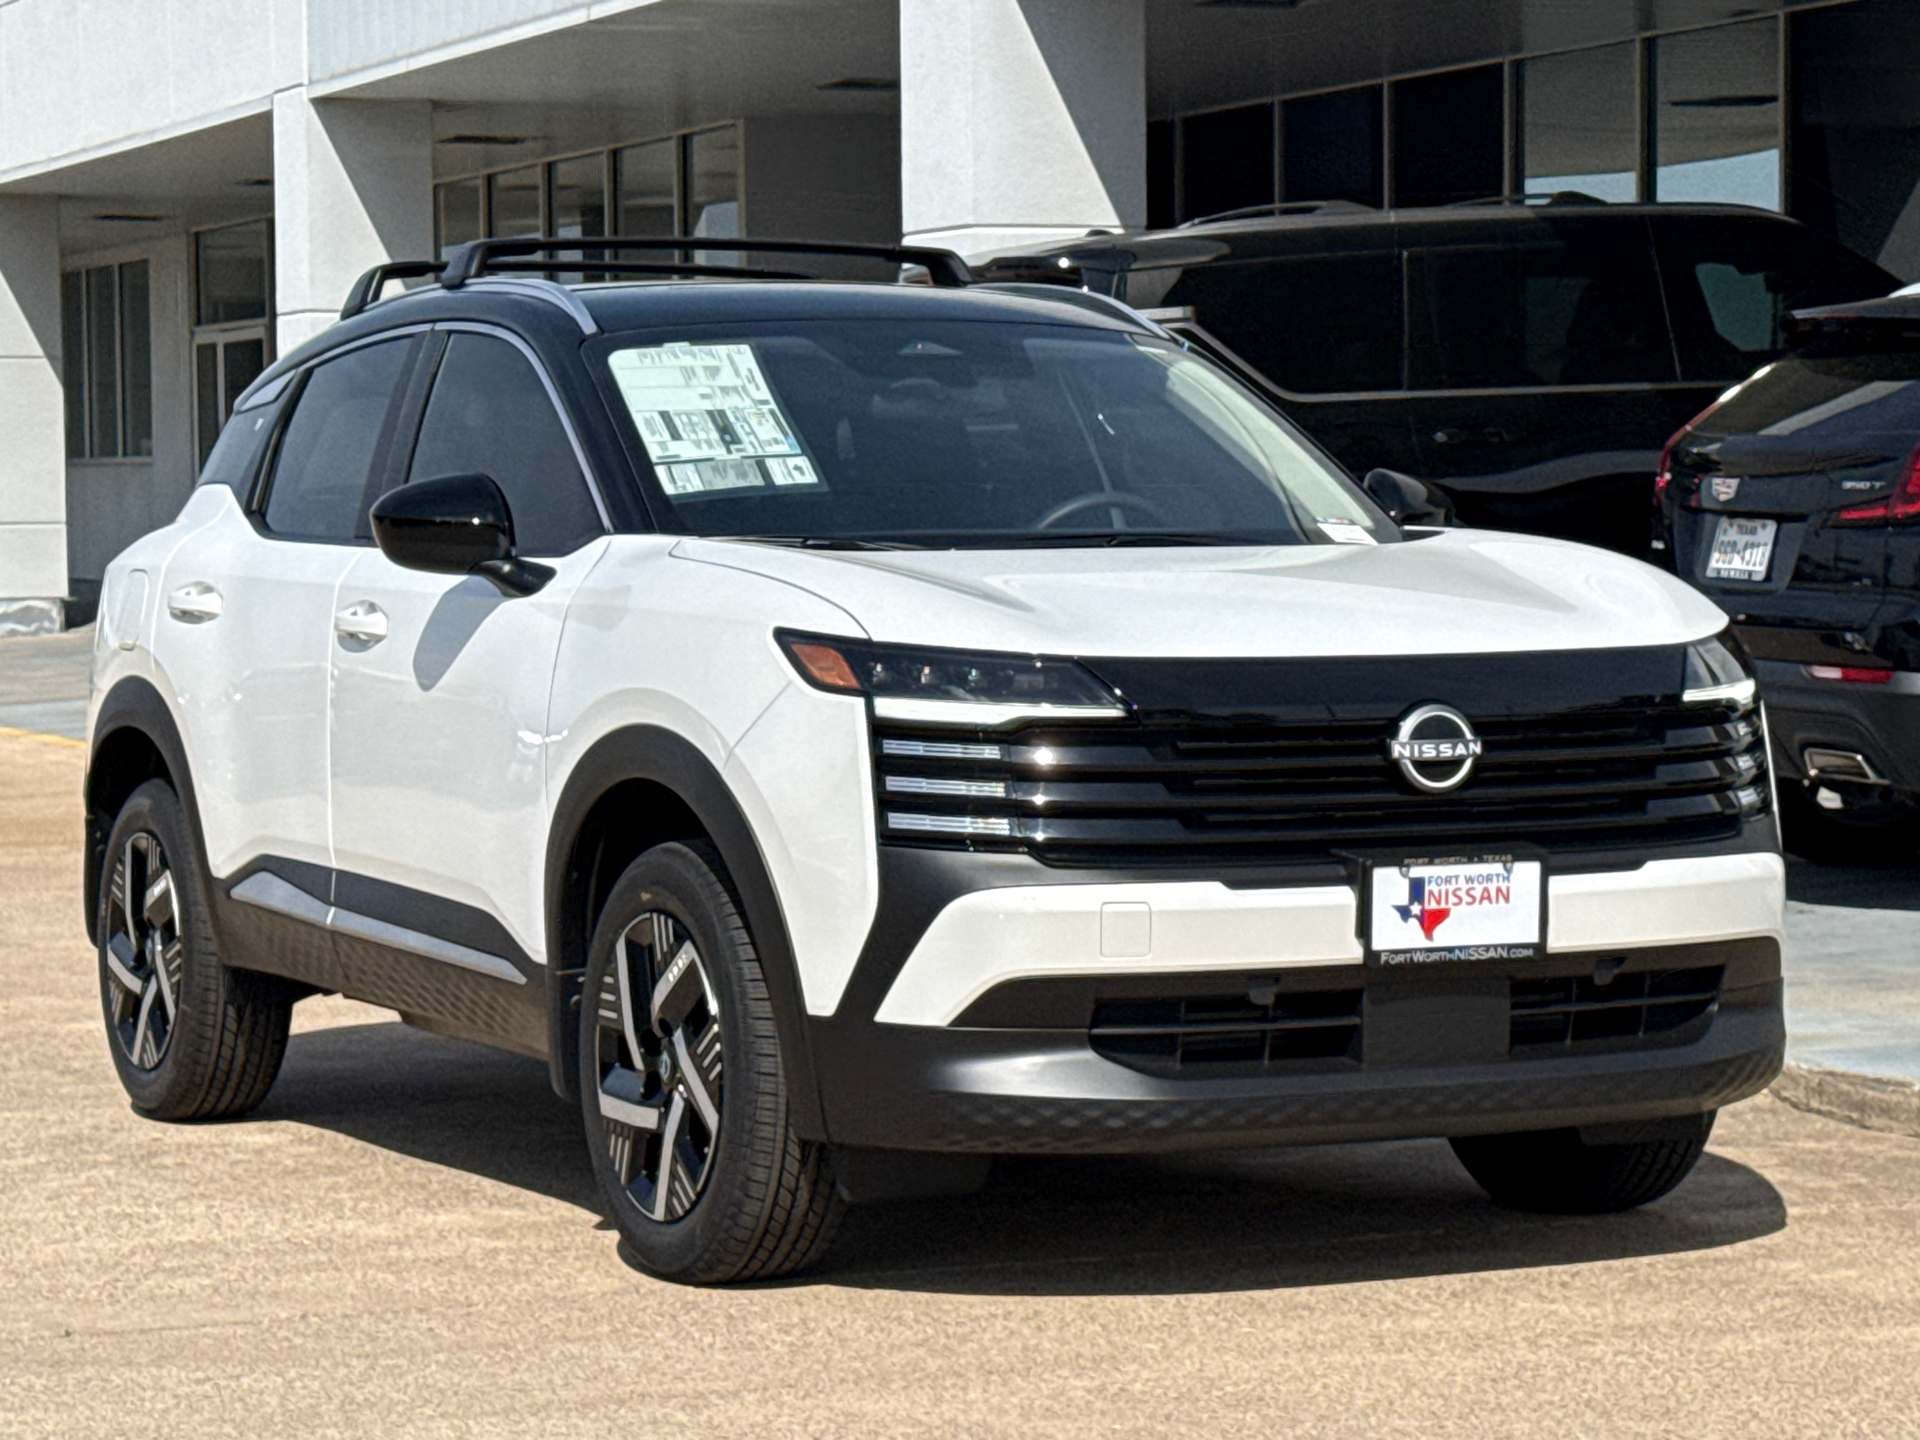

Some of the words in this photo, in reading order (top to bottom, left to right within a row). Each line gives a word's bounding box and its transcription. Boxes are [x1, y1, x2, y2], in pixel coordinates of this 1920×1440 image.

[1393, 741, 1481, 758] NISSAN
[1427, 874, 1460, 887] FORT
[1464, 872, 1511, 886] WORTH
[1427, 885, 1511, 907] NISSAN
